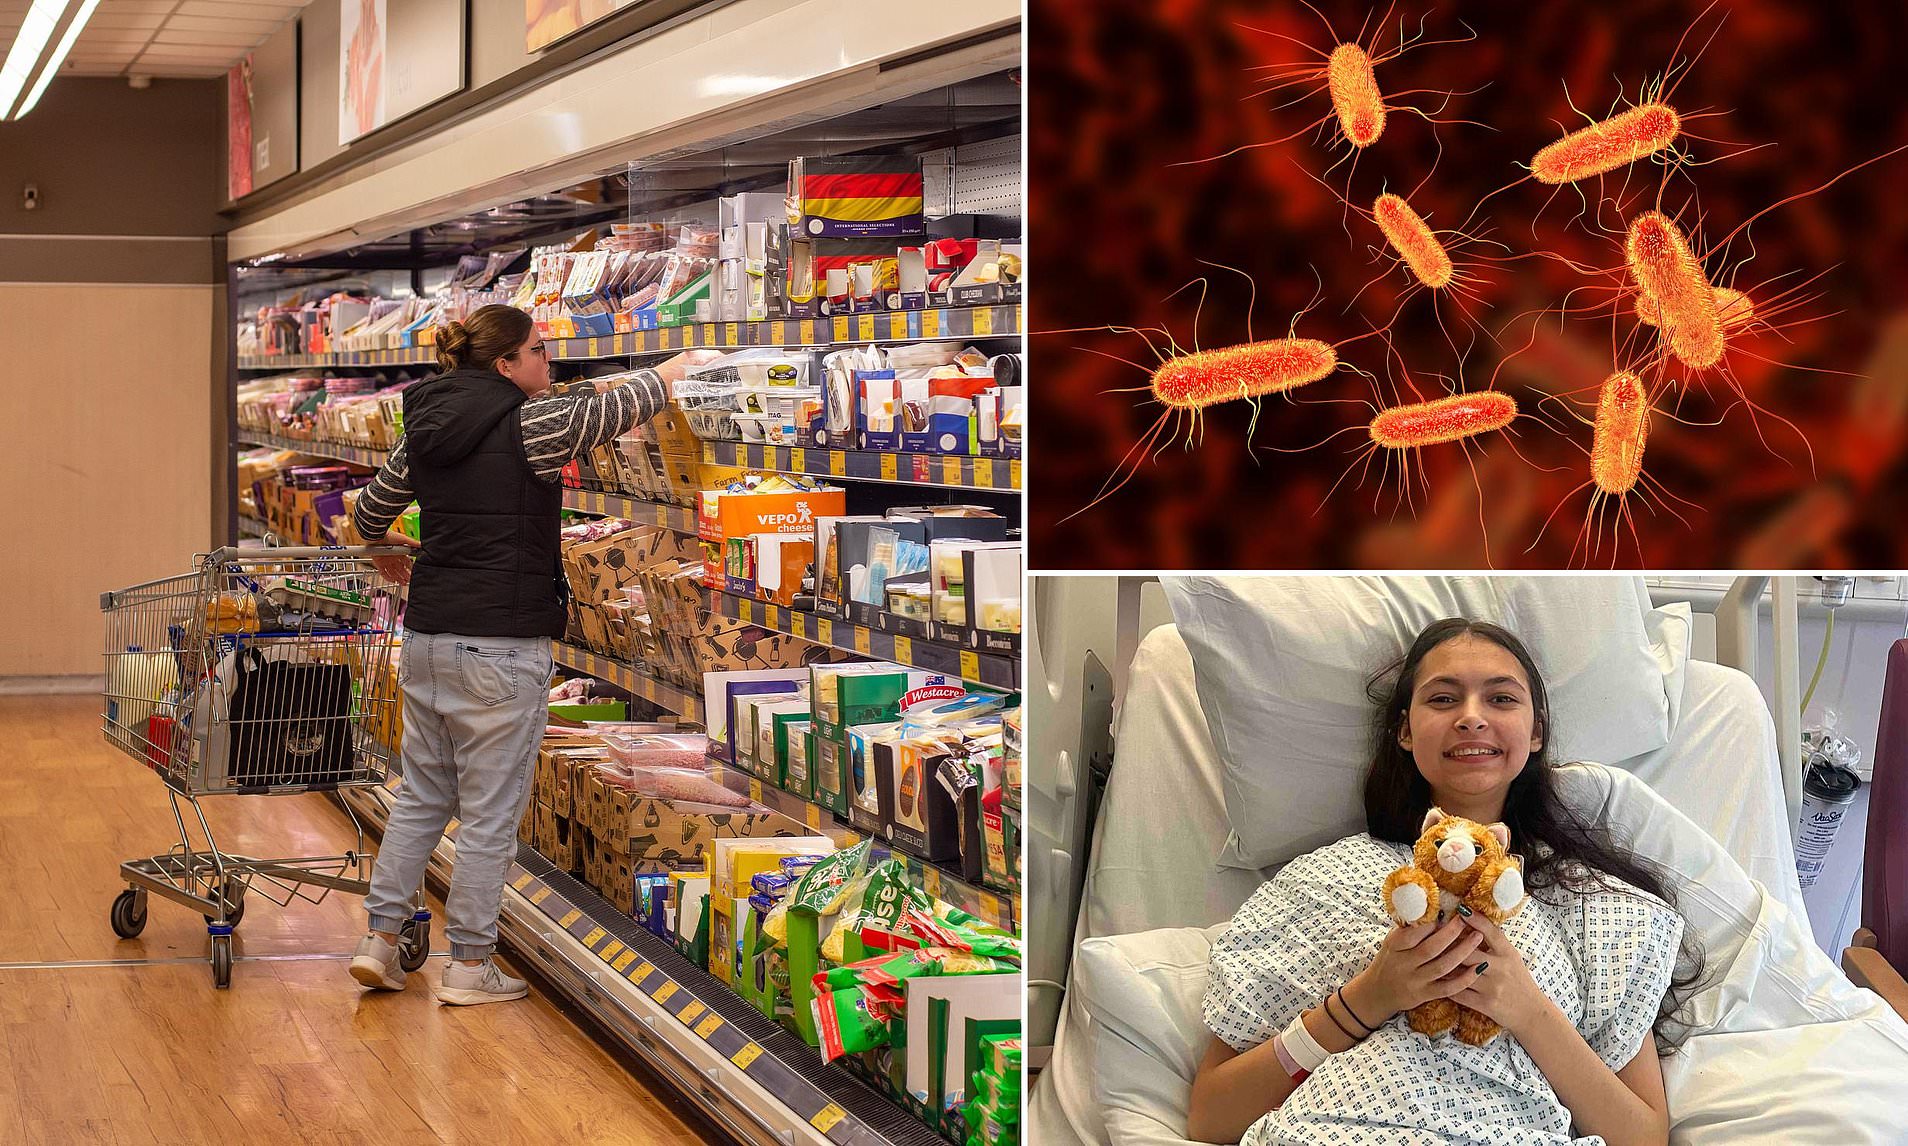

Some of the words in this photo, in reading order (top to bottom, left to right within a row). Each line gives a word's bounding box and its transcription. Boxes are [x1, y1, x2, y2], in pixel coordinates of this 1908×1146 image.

[713, 476, 738, 488] Farm
[757, 513, 797, 525] VEPO
[777, 523, 814, 533] cheese
[911, 687, 960, 702] Westacre
